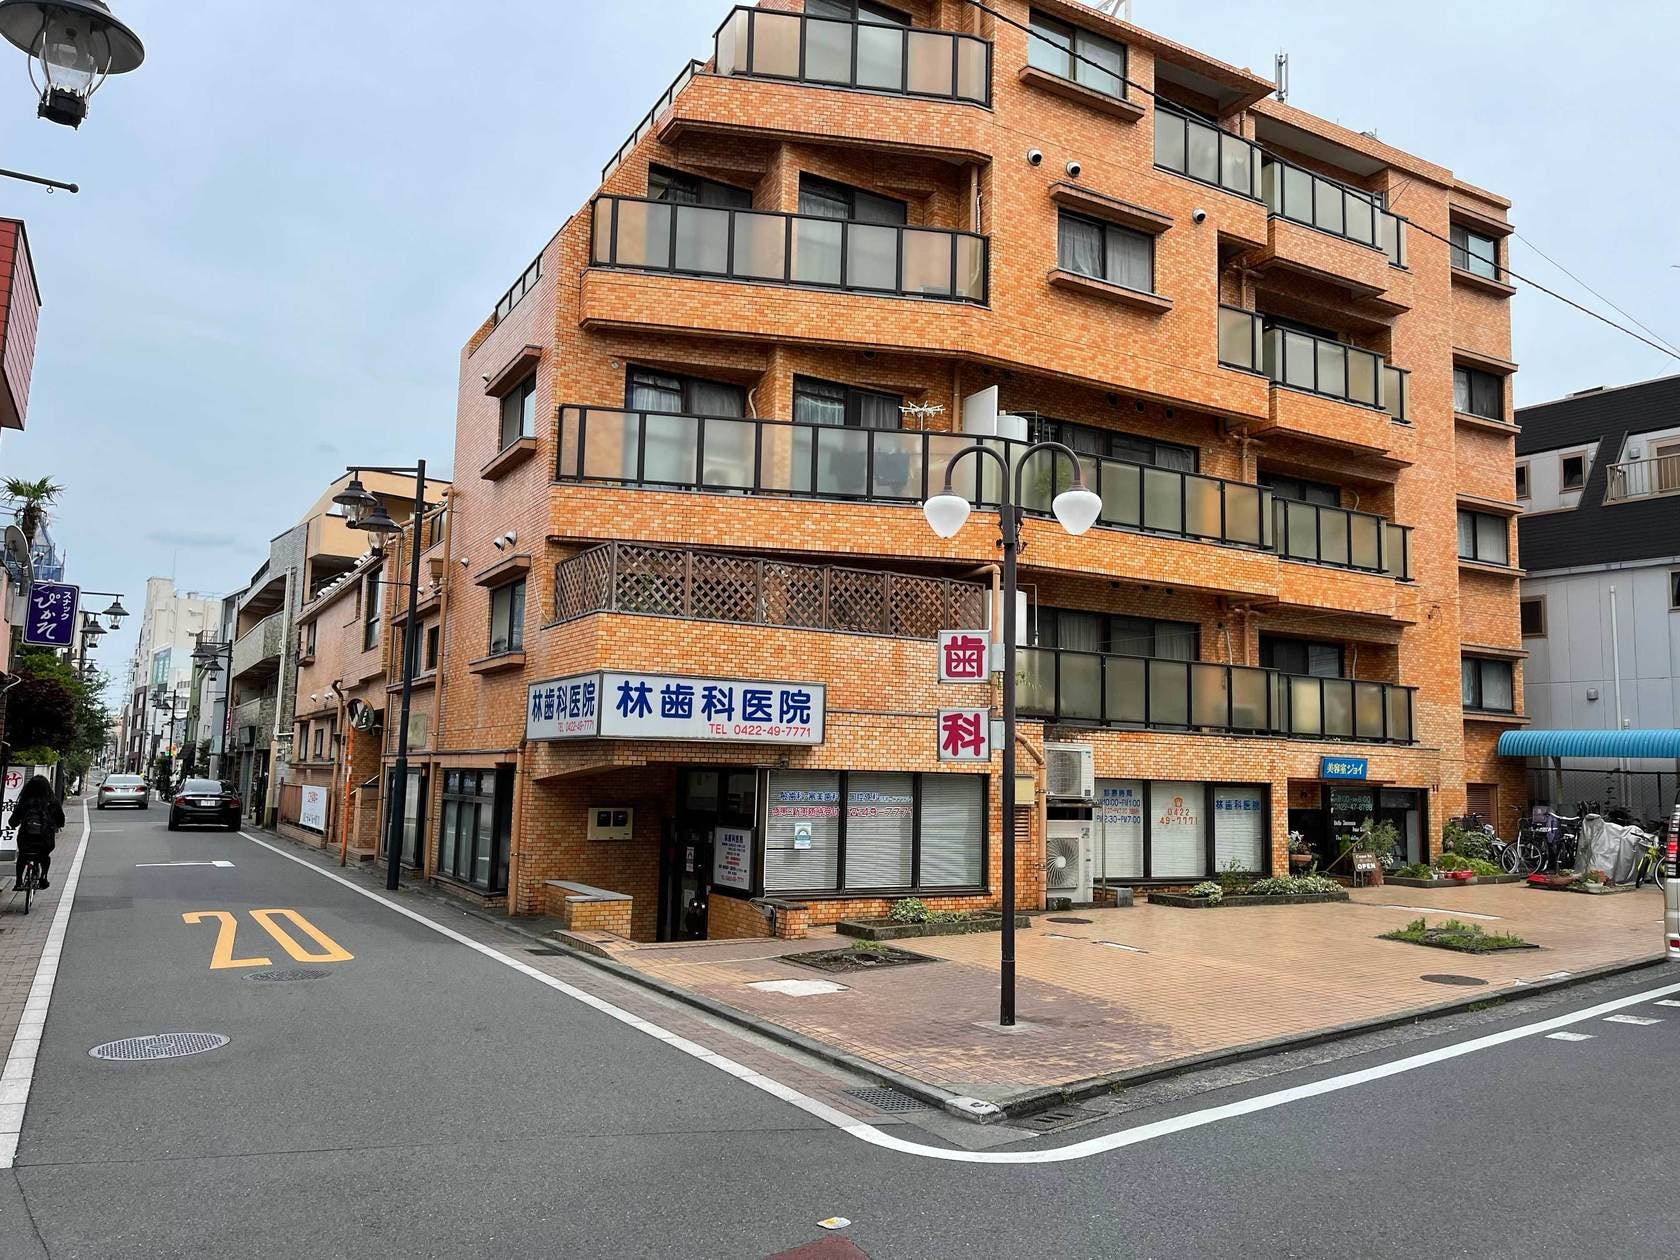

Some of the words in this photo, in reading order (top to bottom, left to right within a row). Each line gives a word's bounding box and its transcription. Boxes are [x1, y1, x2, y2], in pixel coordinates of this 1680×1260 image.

[33, 593, 61, 640] ぴかそ
[61, 591, 72, 620] スナック
[944, 635, 986, 678] 歯
[532, 680, 595, 722] 林歯科医院
[616, 680, 811, 724] 林歯科医院
[709, 723, 727, 735] TEL
[733, 724, 811, 738] 0422-49-7771
[942, 713, 985, 757] 科
[1327, 762, 1363, 775] 美容室ジョイ
[1159, 817, 1199, 825] 49-7771
[1167, 808, 1190, 816] 0422
[1357, 862, 1376, 870] OPEN
[182, 908, 355, 969] 20
